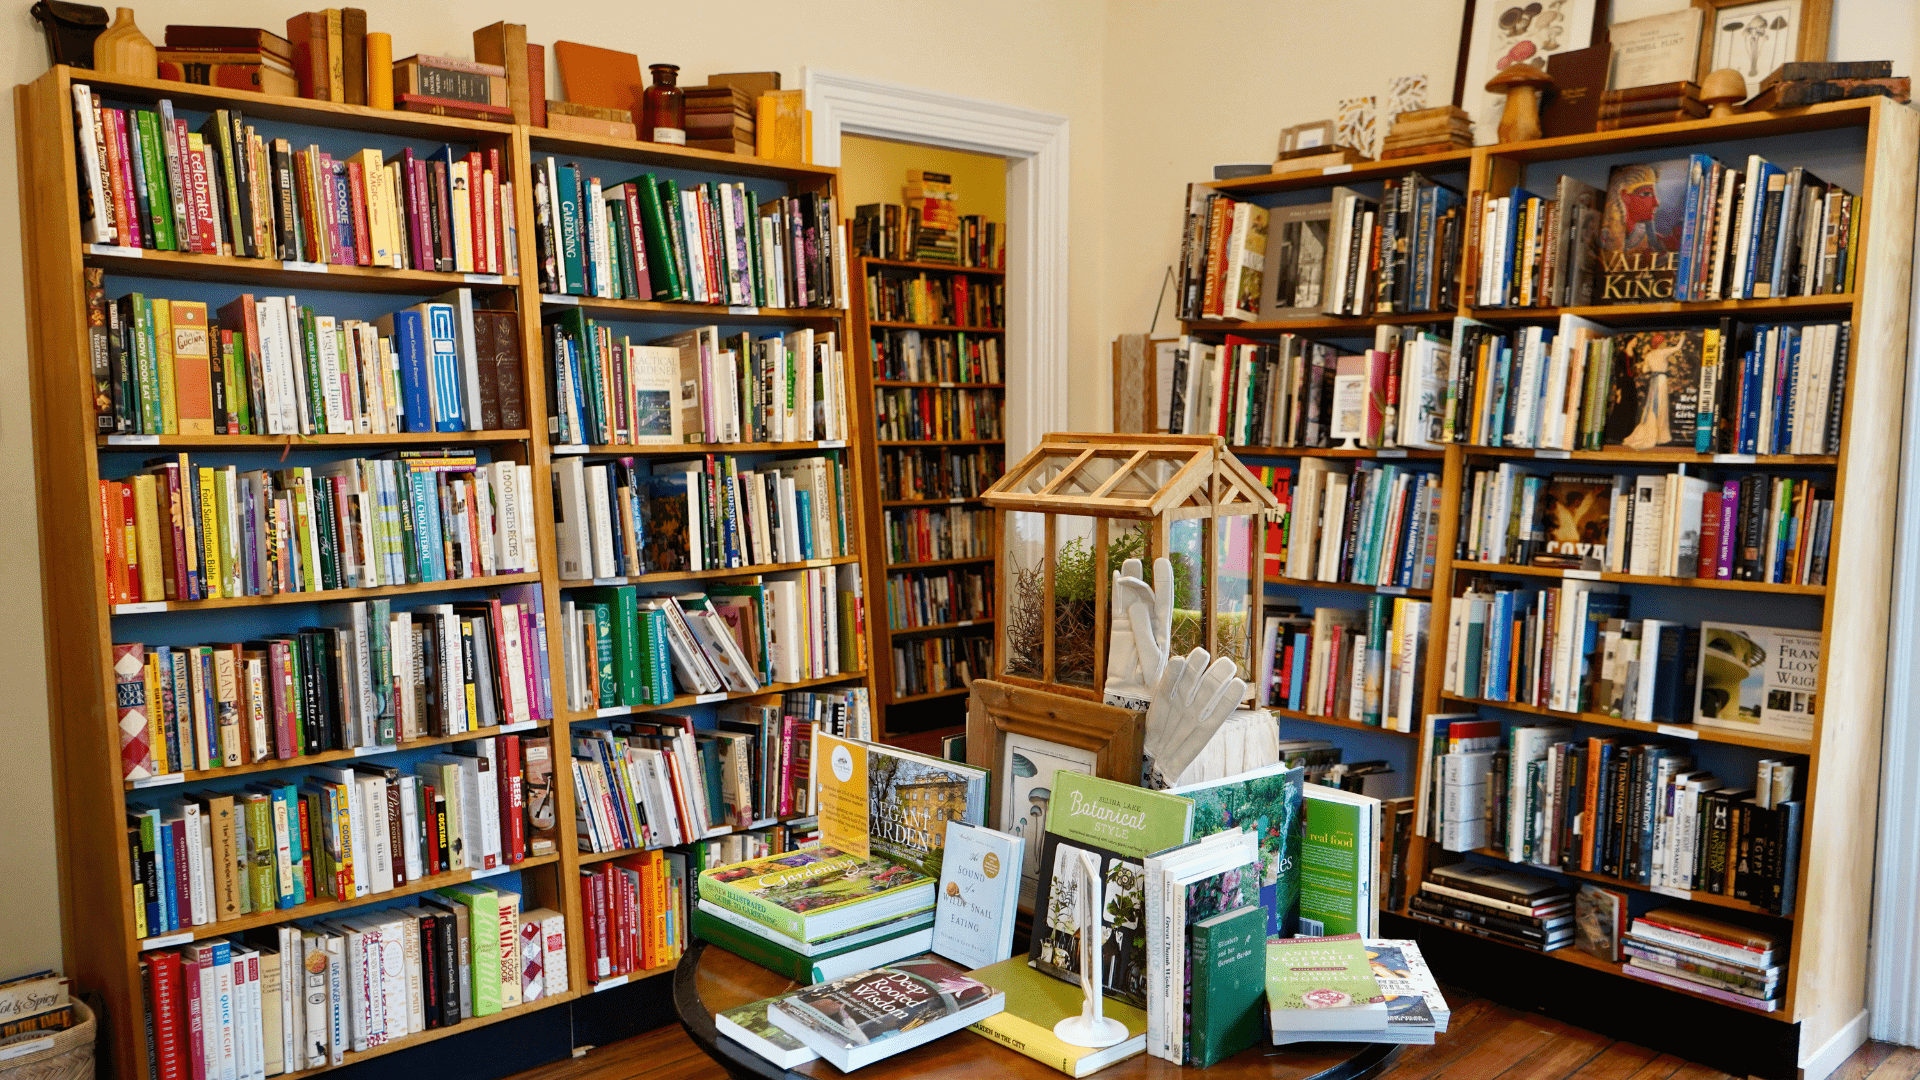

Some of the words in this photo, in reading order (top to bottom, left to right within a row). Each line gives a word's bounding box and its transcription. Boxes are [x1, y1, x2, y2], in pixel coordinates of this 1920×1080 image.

[234, 119, 244, 143] Cookies!
[170, 145, 182, 198] GINGERBREAD
[373, 155, 381, 172] Cake
[191, 153, 213, 223] celebrate!
[280, 169, 290, 188] BAKED
[369, 171, 378, 200] MAGIC
[282, 189, 293, 232] EXPLORATIONS
[337, 183, 349, 224] COOKIE
[629, 195, 639, 224] National
[562, 201, 576, 258] GARDENING
[634, 226, 642, 252] Garden
[637, 253, 645, 272] Book
[1601, 250, 1680, 273] VALLE
[1601, 275, 1673, 299] KING
[94, 334, 102, 368] VEGETARIAN
[138, 332, 146, 357] GROW
[209, 326, 220, 357] Vegetarian
[307, 332, 315, 353] COME
[140, 360, 148, 383] COOK
[212, 358, 220, 372] Grill
[309, 354, 317, 377] HOME
[323, 329, 337, 385] Vegetarian
[330, 387, 341, 419] Times
[633, 356, 676, 366] RACTICAL
[635, 366, 676, 376] ARDENER
[312, 378, 318, 388] TO
[314, 389, 322, 418] DINNER
[1675, 402, 1696, 411] Rose
[1680, 393, 1697, 402] Red
[1675, 410, 1696, 419] Girls
[202, 489, 211, 507] Food
[415, 484, 424, 502] LOW
[726, 476, 736, 531] GARDENING
[268, 508, 276, 524] MY
[403, 514, 412, 531] well
[504, 494, 516, 529] DIABETES
[203, 508, 214, 558] Substitutions
[269, 529, 278, 562] PIZZA
[418, 505, 430, 560] CHOLESTEROL
[507, 530, 518, 558] RECIPES
[207, 560, 216, 580] Bible
[359, 630, 369, 668] ITALIAN
[538, 631, 547, 652] INDIAN
[1780, 645, 1819, 660] FRAN
[175, 655, 185, 680] MIAMI
[656, 615, 664, 644] Illustrated
[661, 669, 670, 700] Gardening
[1779, 657, 1817, 672] LLOY
[120, 683, 141, 692] NEW
[219, 657, 234, 699] ASIAN
[362, 670, 371, 712] COOKING
[118, 690, 144, 700] COOK
[119, 697, 144, 706] BOOK
[512, 776, 522, 807] BEERS
[894, 796, 903, 806] The
[1099, 796, 1121, 808] SELINA
[1123, 802, 1141, 813] LAKE
[1615, 762, 1626, 824] TUTANKHAMUN
[387, 790, 400, 821] Paris
[870, 799, 931, 831] LEGANT
[1070, 790, 1146, 830] Botanical
[438, 813, 446, 848] COCKTAILS
[870, 818, 930, 852] ARDEN
[1095, 822, 1129, 840] STYLE
[1310, 833, 1328, 843] real
[1331, 835, 1353, 848] food
[1709, 829, 1719, 870] MYSTERY
[1717, 842, 1725, 873] SPHINX
[1753, 838, 1764, 876] EGYPT
[758, 859, 860, 888] Gardening
[958, 865, 985, 883] SOUND
[715, 887, 726, 896] NEW
[727, 892, 766, 914] ILLUSTRATED
[734, 900, 742, 908] TO
[943, 892, 963, 907] WILD
[971, 903, 992, 920] SNAIL
[499, 906, 514, 959] McCALL'S
[950, 913, 980, 932] EATING
[405, 924, 413, 958] GOURMET
[473, 894, 501, 1005] Gourmet
[331, 962, 339, 976] LIVE
[220, 974, 228, 993] THE
[332, 978, 340, 1003] LONGER
[869, 978, 927, 1009] Rooted
[23, 993, 58, 1011] Spicy
[204, 973, 215, 1023] RESTAURANT
[220, 995, 230, 1025] QUICK
[852, 984, 910, 1020] Wisdom
[206, 1026, 217, 1069] FAVORITES
[223, 1027, 231, 1060] RECIPE
[1001, 1035, 1011, 1044] THE
[1012, 1039, 1025, 1050] CITY
